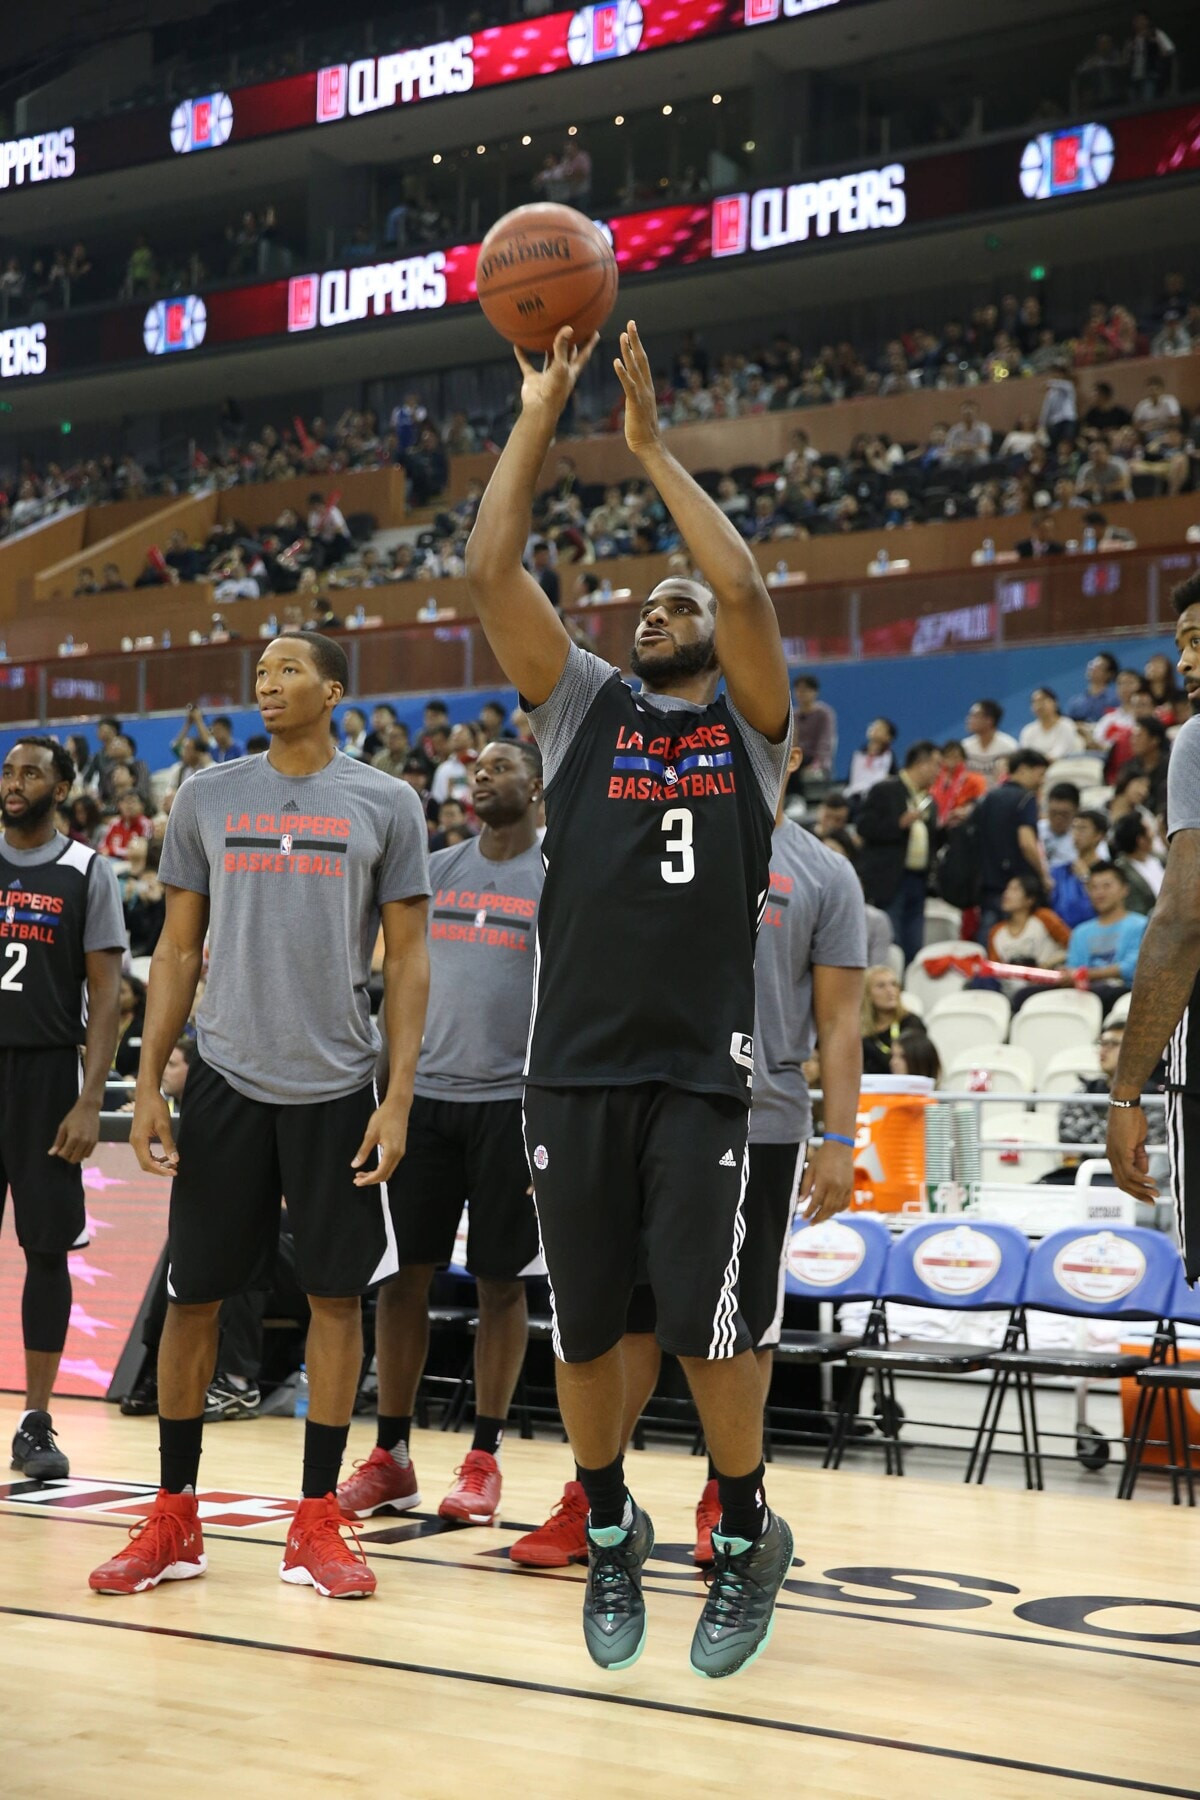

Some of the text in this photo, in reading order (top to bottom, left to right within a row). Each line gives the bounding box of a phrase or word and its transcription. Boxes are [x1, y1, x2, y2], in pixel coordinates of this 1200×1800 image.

[348, 34, 474, 117] CLIPPERS
[750, 163, 906, 251] CLIPPERS
[319, 251, 447, 327] CLIPPERS
[616, 725, 644, 751] LA
[225, 812, 351, 838] LA CLIPPERS
[660, 807, 696, 884] 3
[224, 852, 344, 877] BASKETBALL
[435, 889, 537, 918] LA CLIPPERS
[430, 922, 528, 952] BASKETBALL
